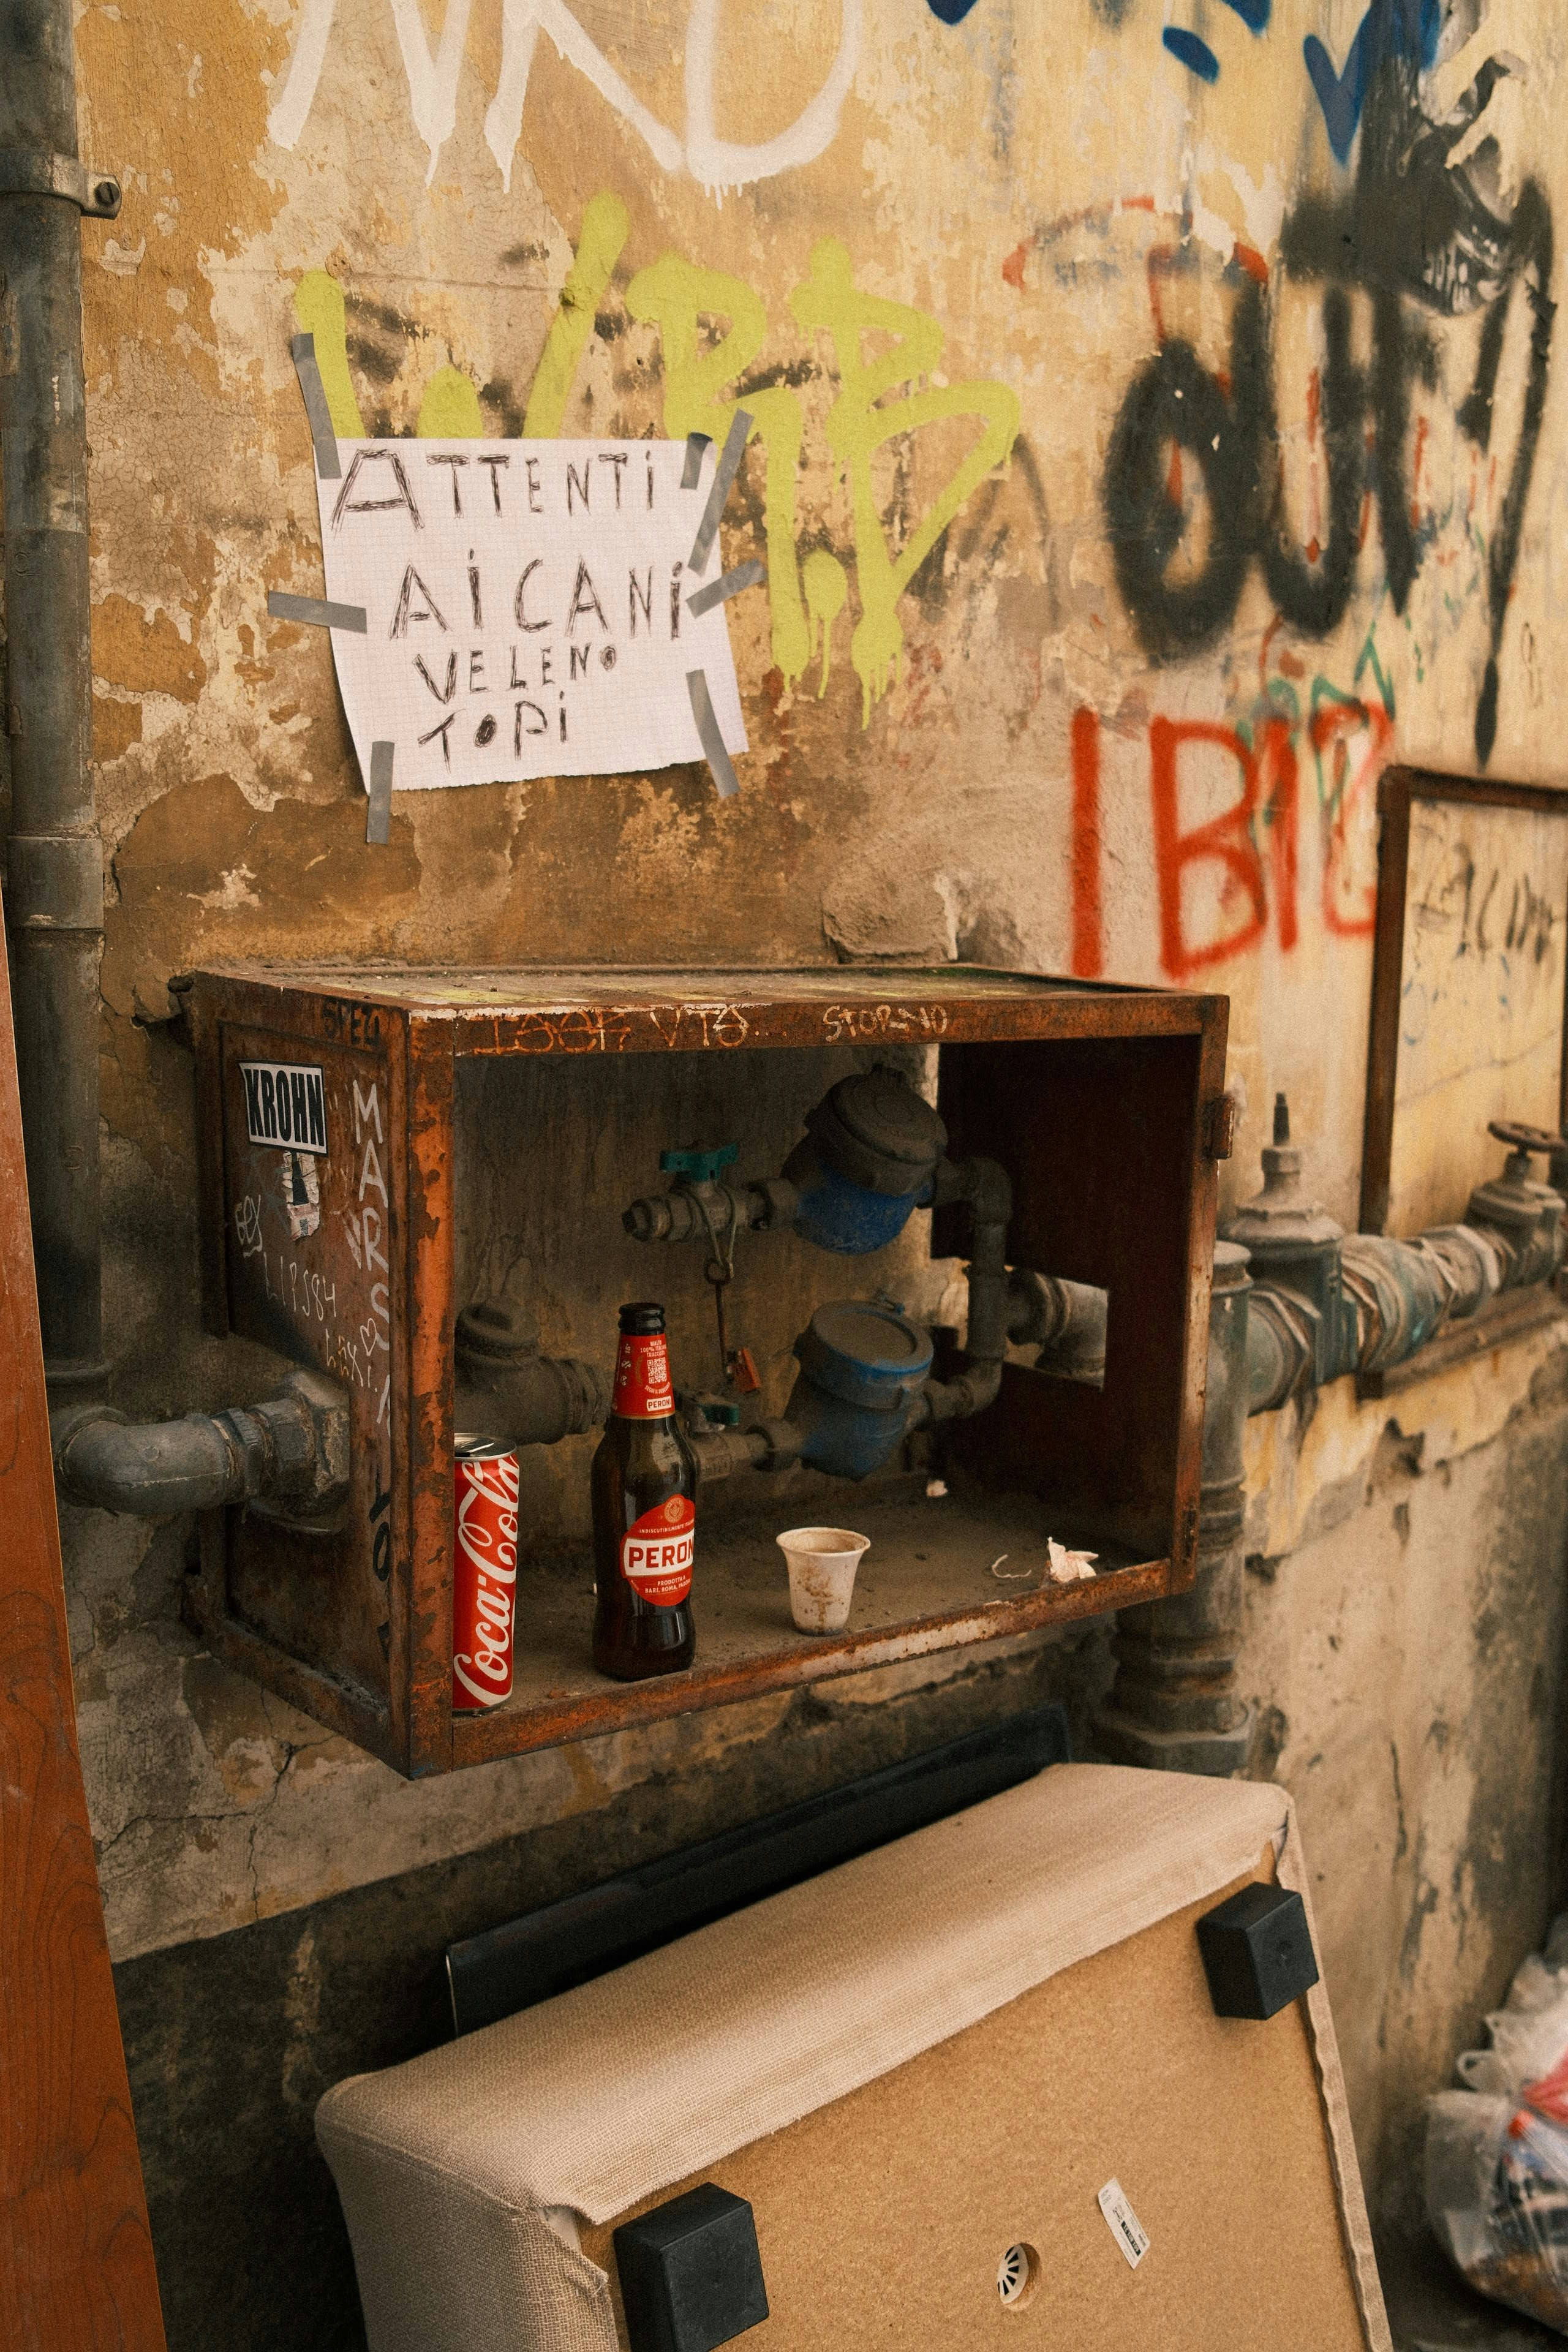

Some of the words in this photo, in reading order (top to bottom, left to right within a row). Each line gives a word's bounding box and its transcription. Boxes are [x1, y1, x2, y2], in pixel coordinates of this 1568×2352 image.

[412, 642, 617, 705] VELENO
[244, 1068, 325, 1147] KROHN
[647, 1398, 671, 1409] PERONI
[453, 1453, 520, 1706] Coca-Cola
[657, 1576, 682, 1586] PRODOTTA
